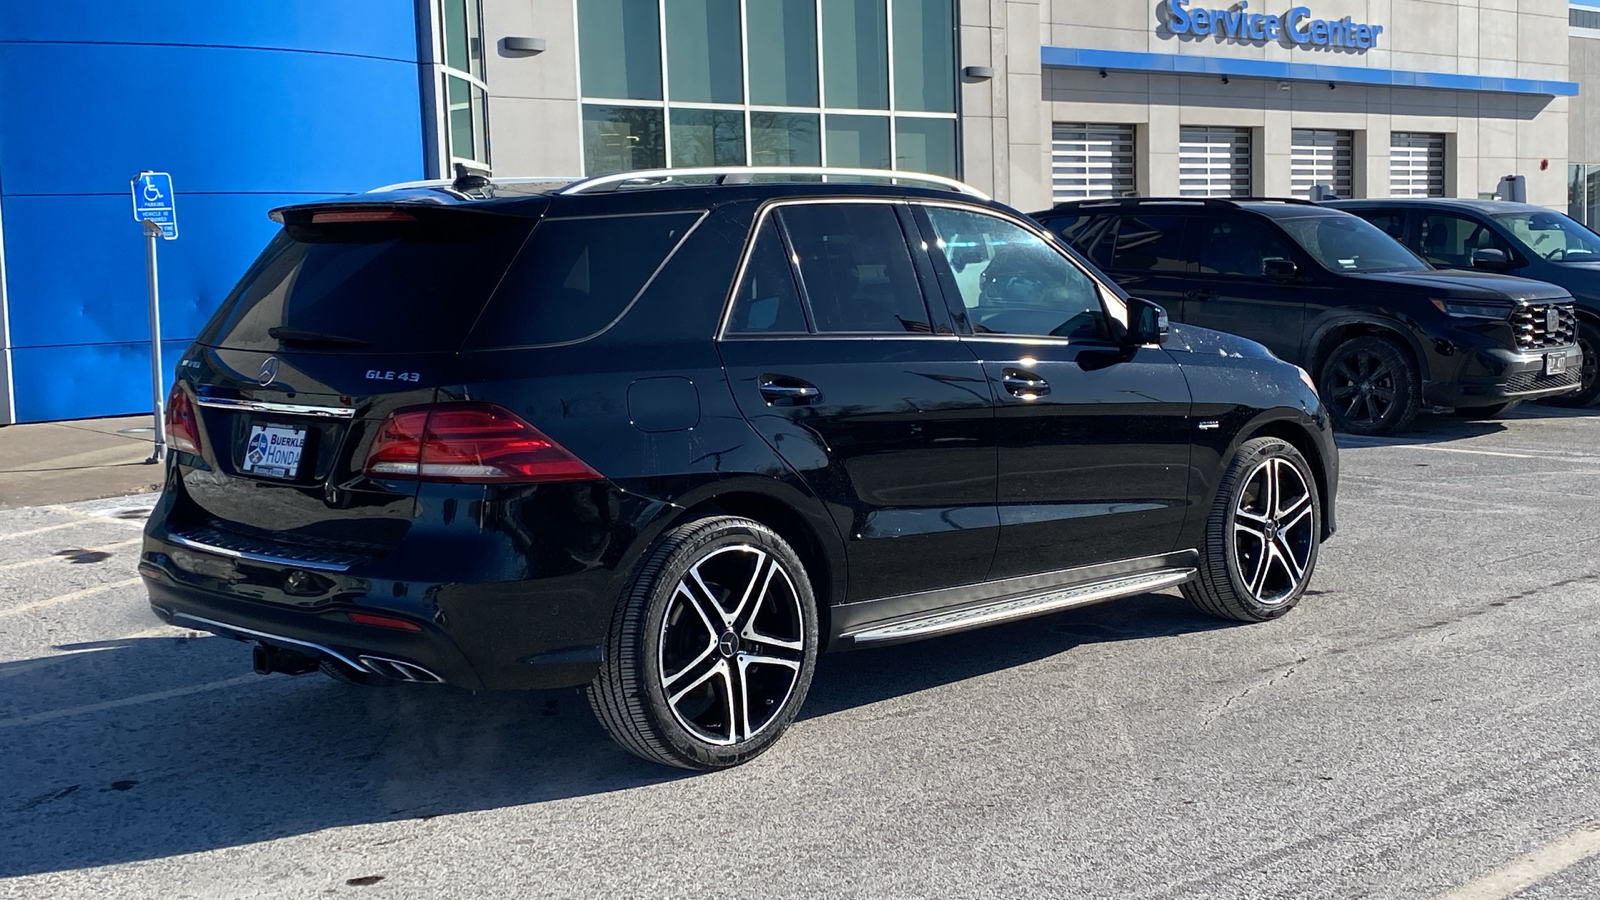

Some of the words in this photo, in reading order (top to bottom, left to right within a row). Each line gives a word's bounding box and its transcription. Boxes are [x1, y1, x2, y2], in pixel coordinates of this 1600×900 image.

[1168, 0, 1280, 39] Service
[1286, 6, 1384, 48] Center
[365, 369, 396, 380] GLE
[397, 372, 420, 382] 43
[270, 433, 305, 448] BUERKLE
[266, 445, 300, 466] HONDA
